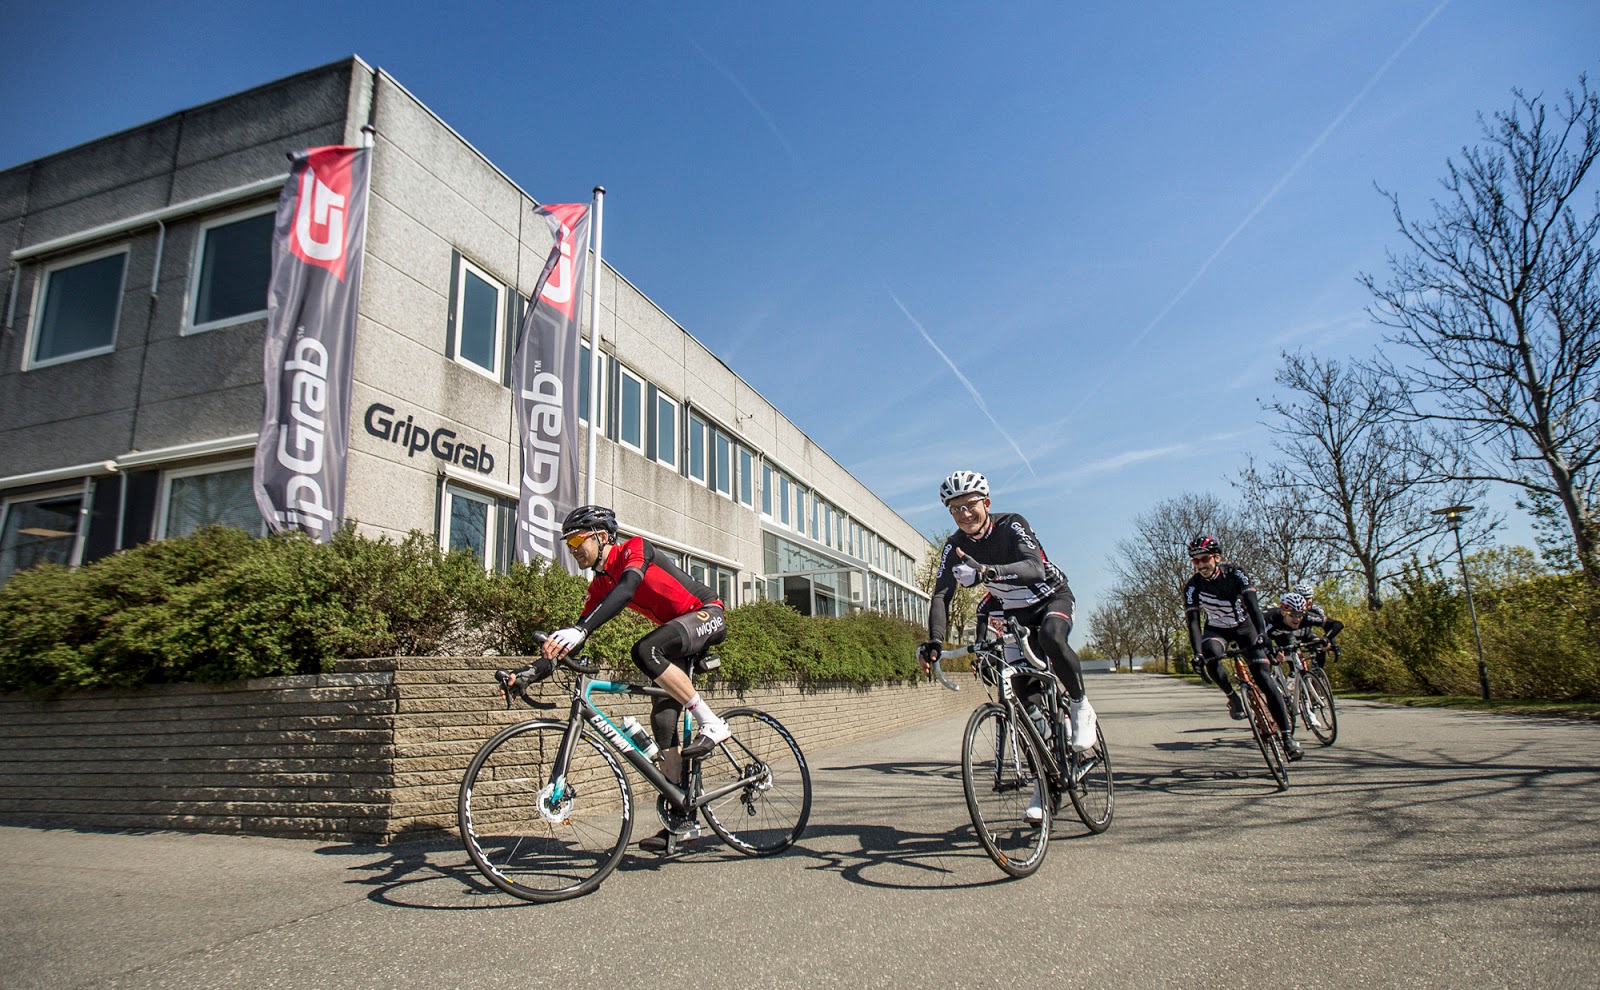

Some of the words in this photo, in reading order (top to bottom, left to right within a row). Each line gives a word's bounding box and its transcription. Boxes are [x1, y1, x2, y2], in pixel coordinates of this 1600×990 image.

[534, 360, 541, 373] TM
[275, 337, 333, 531] ipGrab
[364, 402, 495, 475] GripGrab
[696, 616, 723, 638] wiggle
[590, 714, 635, 753] EASTWAY
